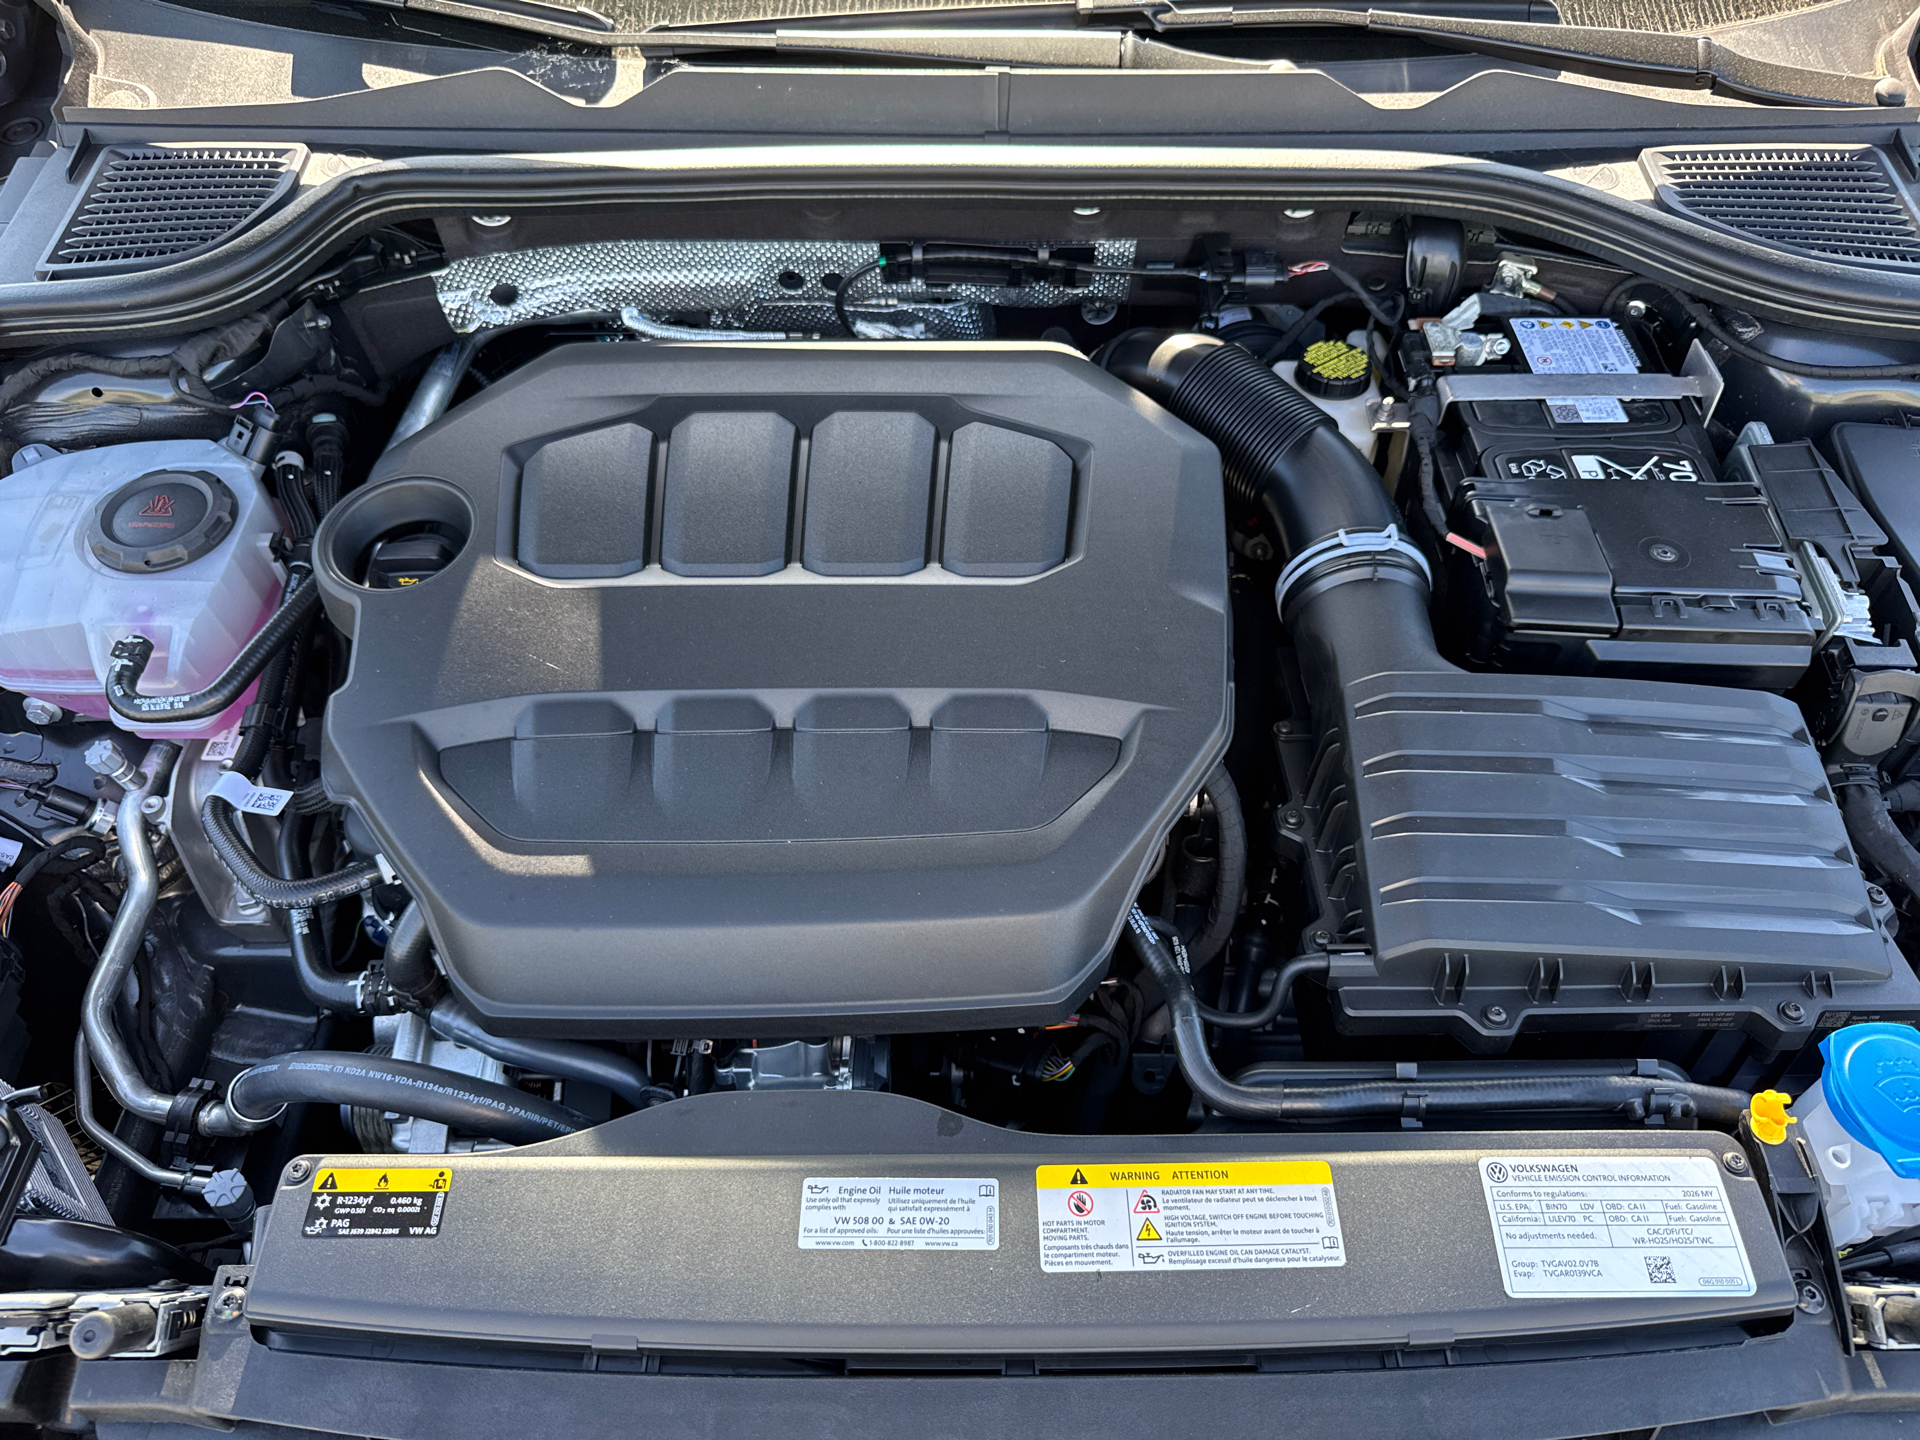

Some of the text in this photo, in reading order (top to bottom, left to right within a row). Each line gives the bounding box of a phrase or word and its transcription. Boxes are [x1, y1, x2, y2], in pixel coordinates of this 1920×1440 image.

[288, 1062, 333, 1072] BRIDGESTONE
[344, 1065, 366, 1077] ND2A
[1509, 1164, 1578, 1173] VOLKSWAGEN
[1110, 1170, 1228, 1181] WARNING ATTENTION
[838, 1186, 881, 1196] Engine Oil
[888, 1186, 945, 1195] Huile moteur
[1543, 1190, 1588, 1199] regulations:
[1682, 1190, 1700, 1198] 2026
[336, 1195, 374, 1206] R-1234yf
[413, 1197, 423, 1206] kg
[853, 1197, 881, 1205] expressly
[911, 1198, 948, 1206] uniquement
[805, 1204, 832, 1212] complies
[330, 1219, 350, 1227] PAG
[834, 1216, 851, 1225] VW
[852, 1216, 870, 1225] 508
[871, 1217, 884, 1225] 00
[900, 1217, 917, 1225] SAE
[919, 1217, 950, 1225] 0W-20
[1502, 1215, 1541, 1223] California:
[409, 1227, 438, 1235] VW AG
[1518, 1232, 1566, 1241] adjustments
[1093, 1242, 1114, 1250] chauds
[1309, 1255, 1341, 1263] catalyseur.
[1511, 1260, 1538, 1269] Group:
[1513, 1270, 1534, 1279] Evap:
